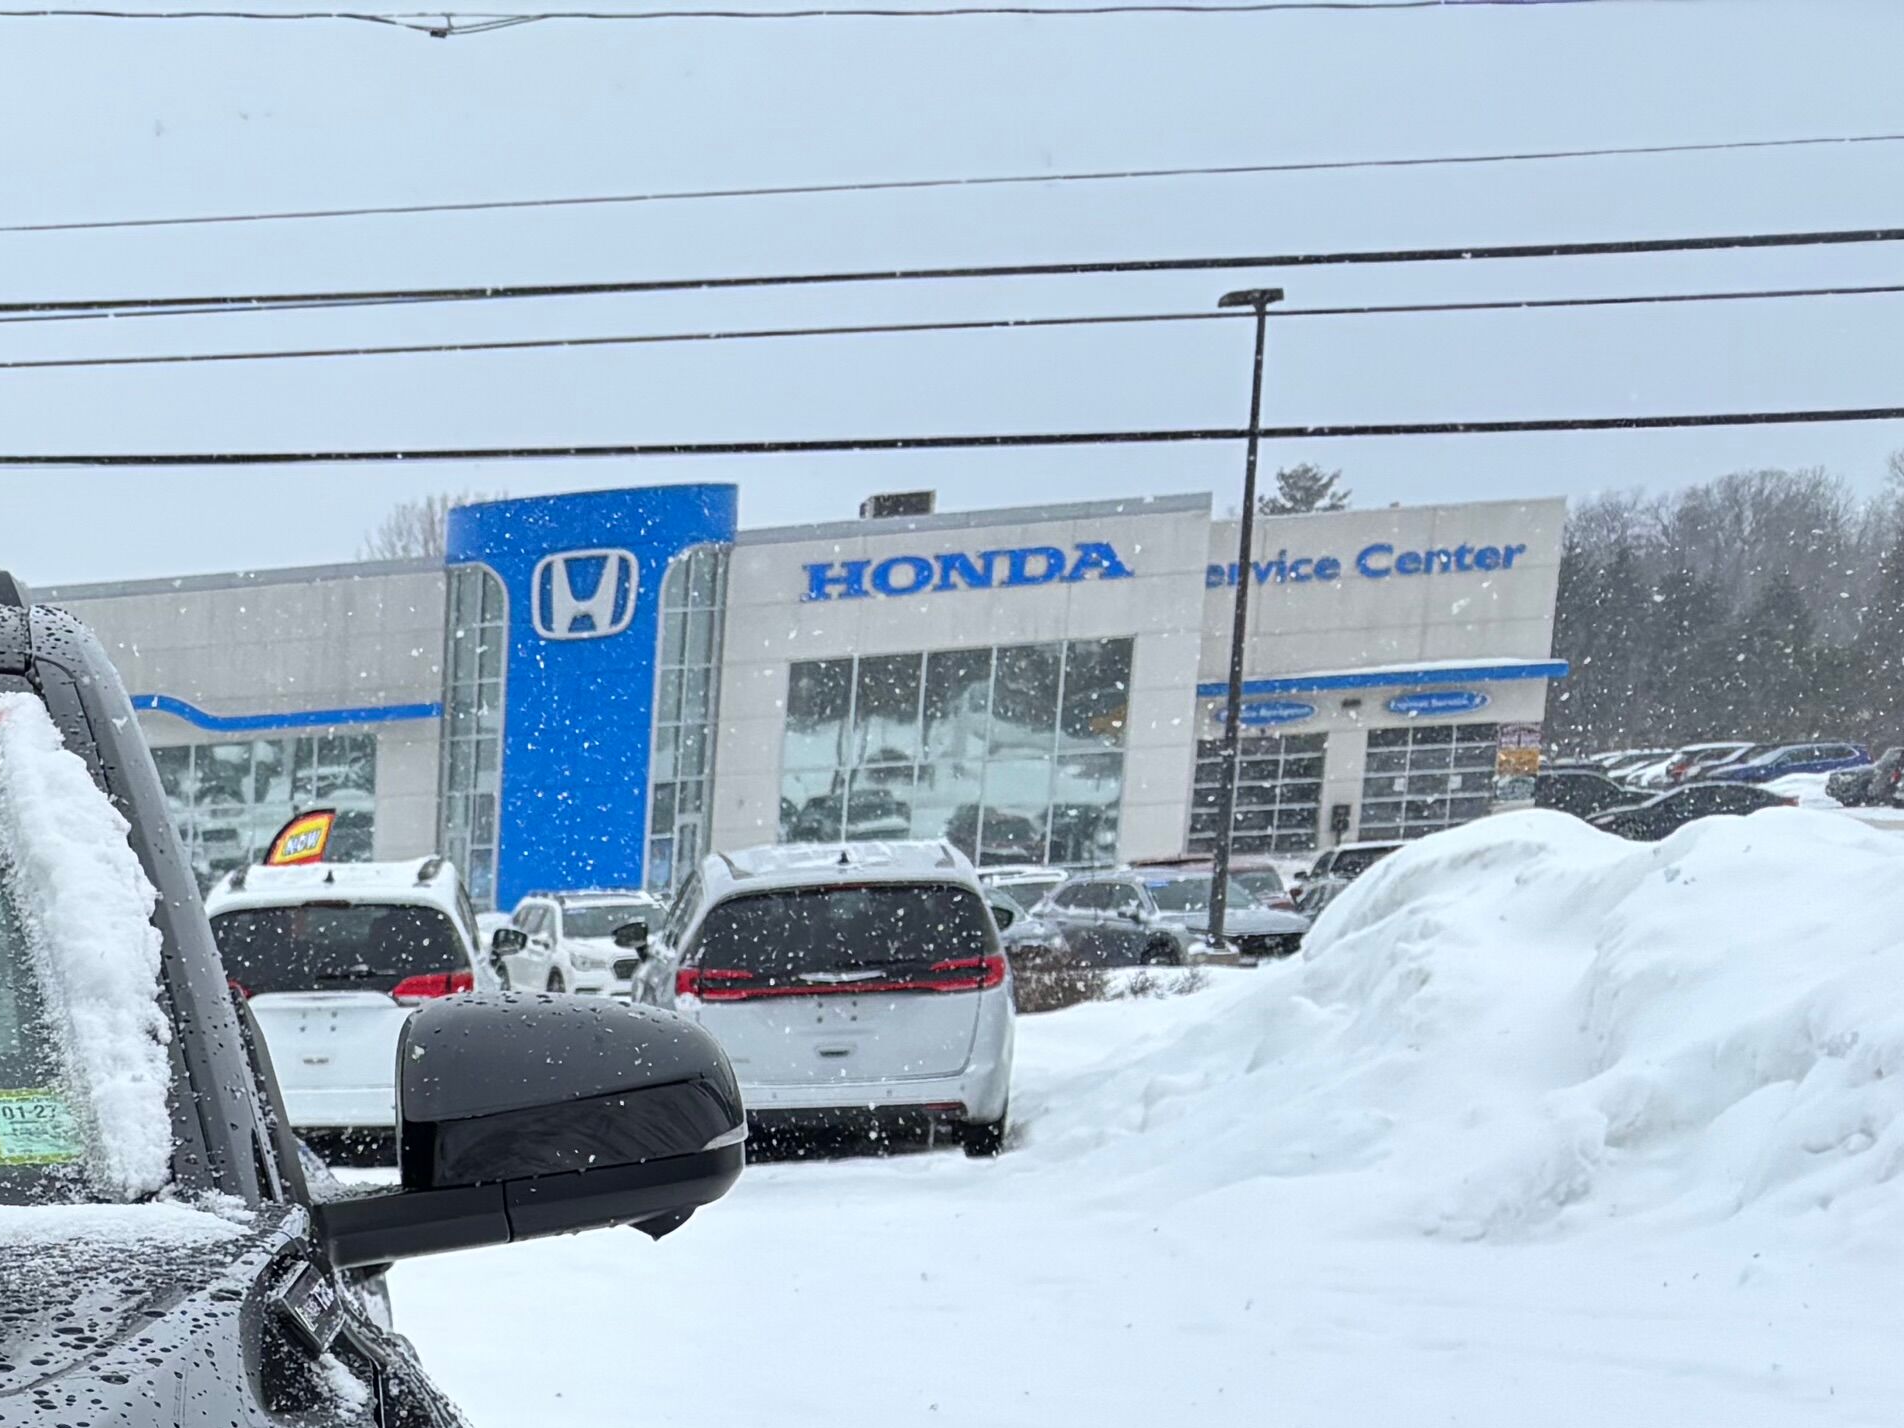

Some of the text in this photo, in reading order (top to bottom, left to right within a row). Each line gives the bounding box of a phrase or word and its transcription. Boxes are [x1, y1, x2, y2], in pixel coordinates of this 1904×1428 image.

[800, 542, 1135, 602] HONDA
[1205, 542, 1527, 588] ervice Center
